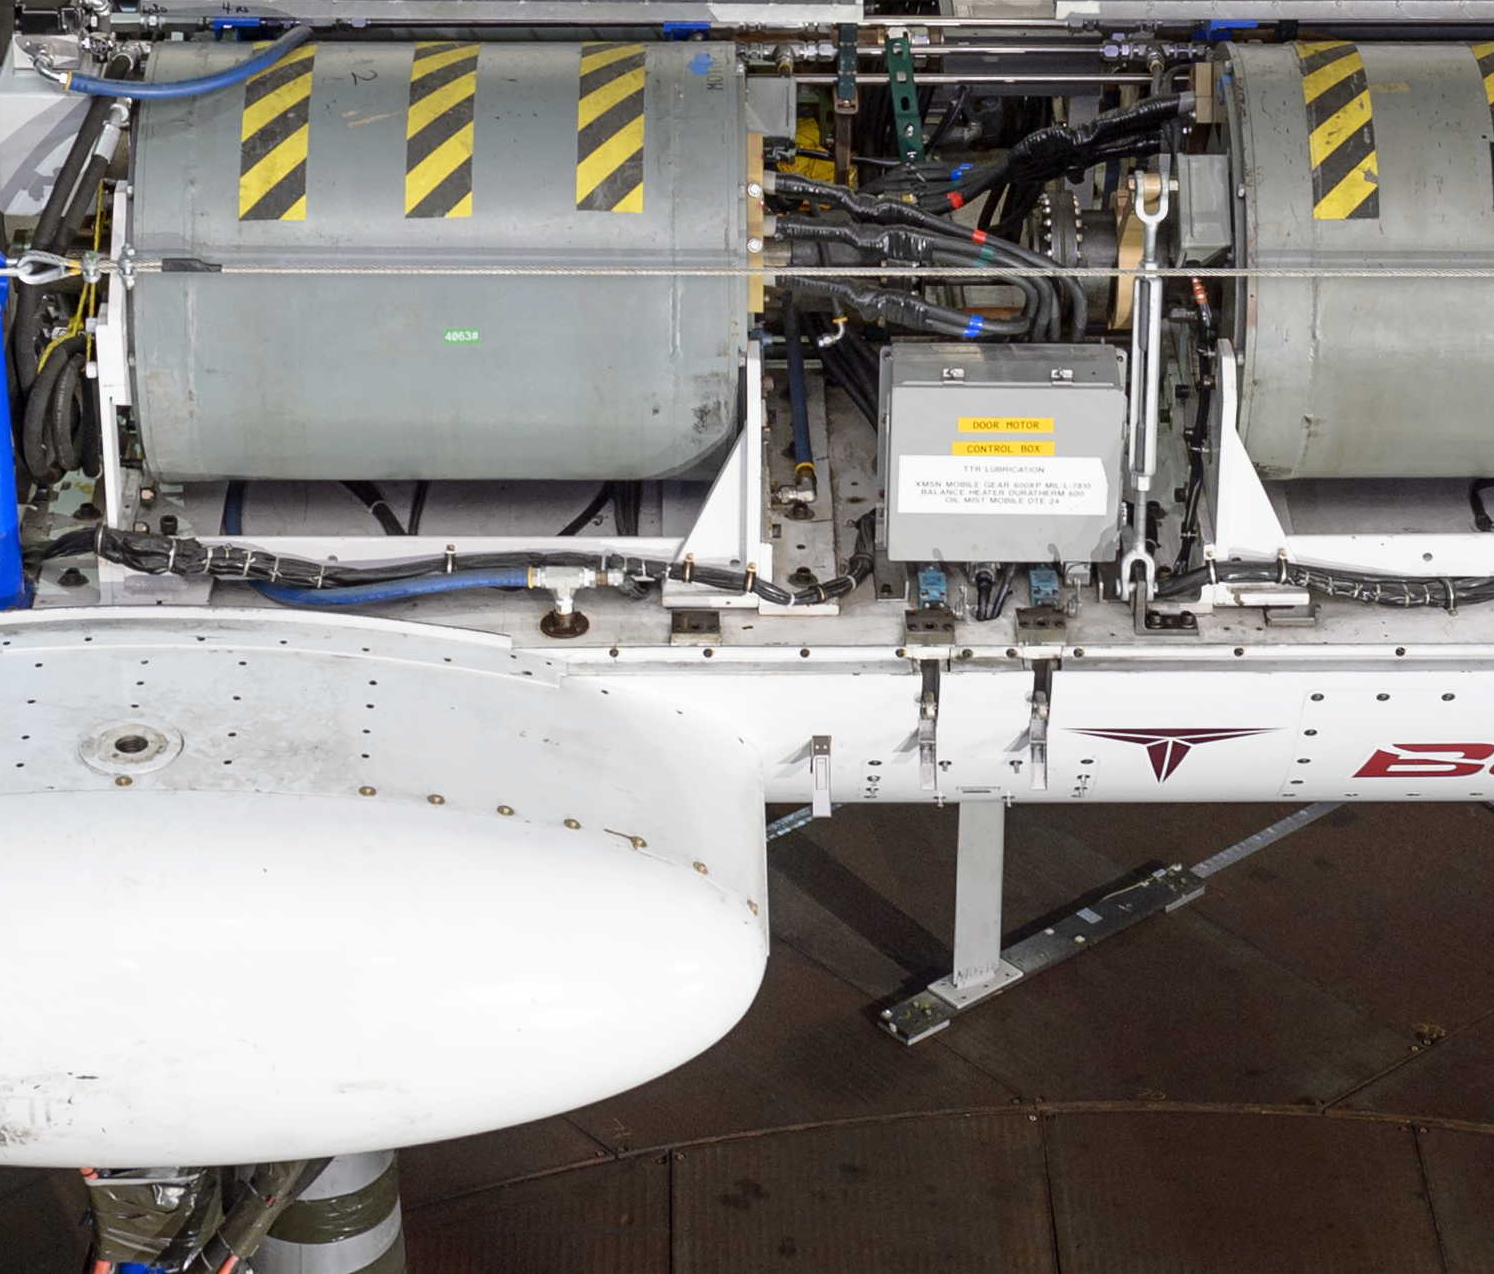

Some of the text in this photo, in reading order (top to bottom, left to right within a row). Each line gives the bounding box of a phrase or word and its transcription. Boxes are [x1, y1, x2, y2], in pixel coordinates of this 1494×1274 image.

[972, 421, 1040, 430] DOOR MOTOR
[966, 445, 1041, 454] CONTROL BOX
